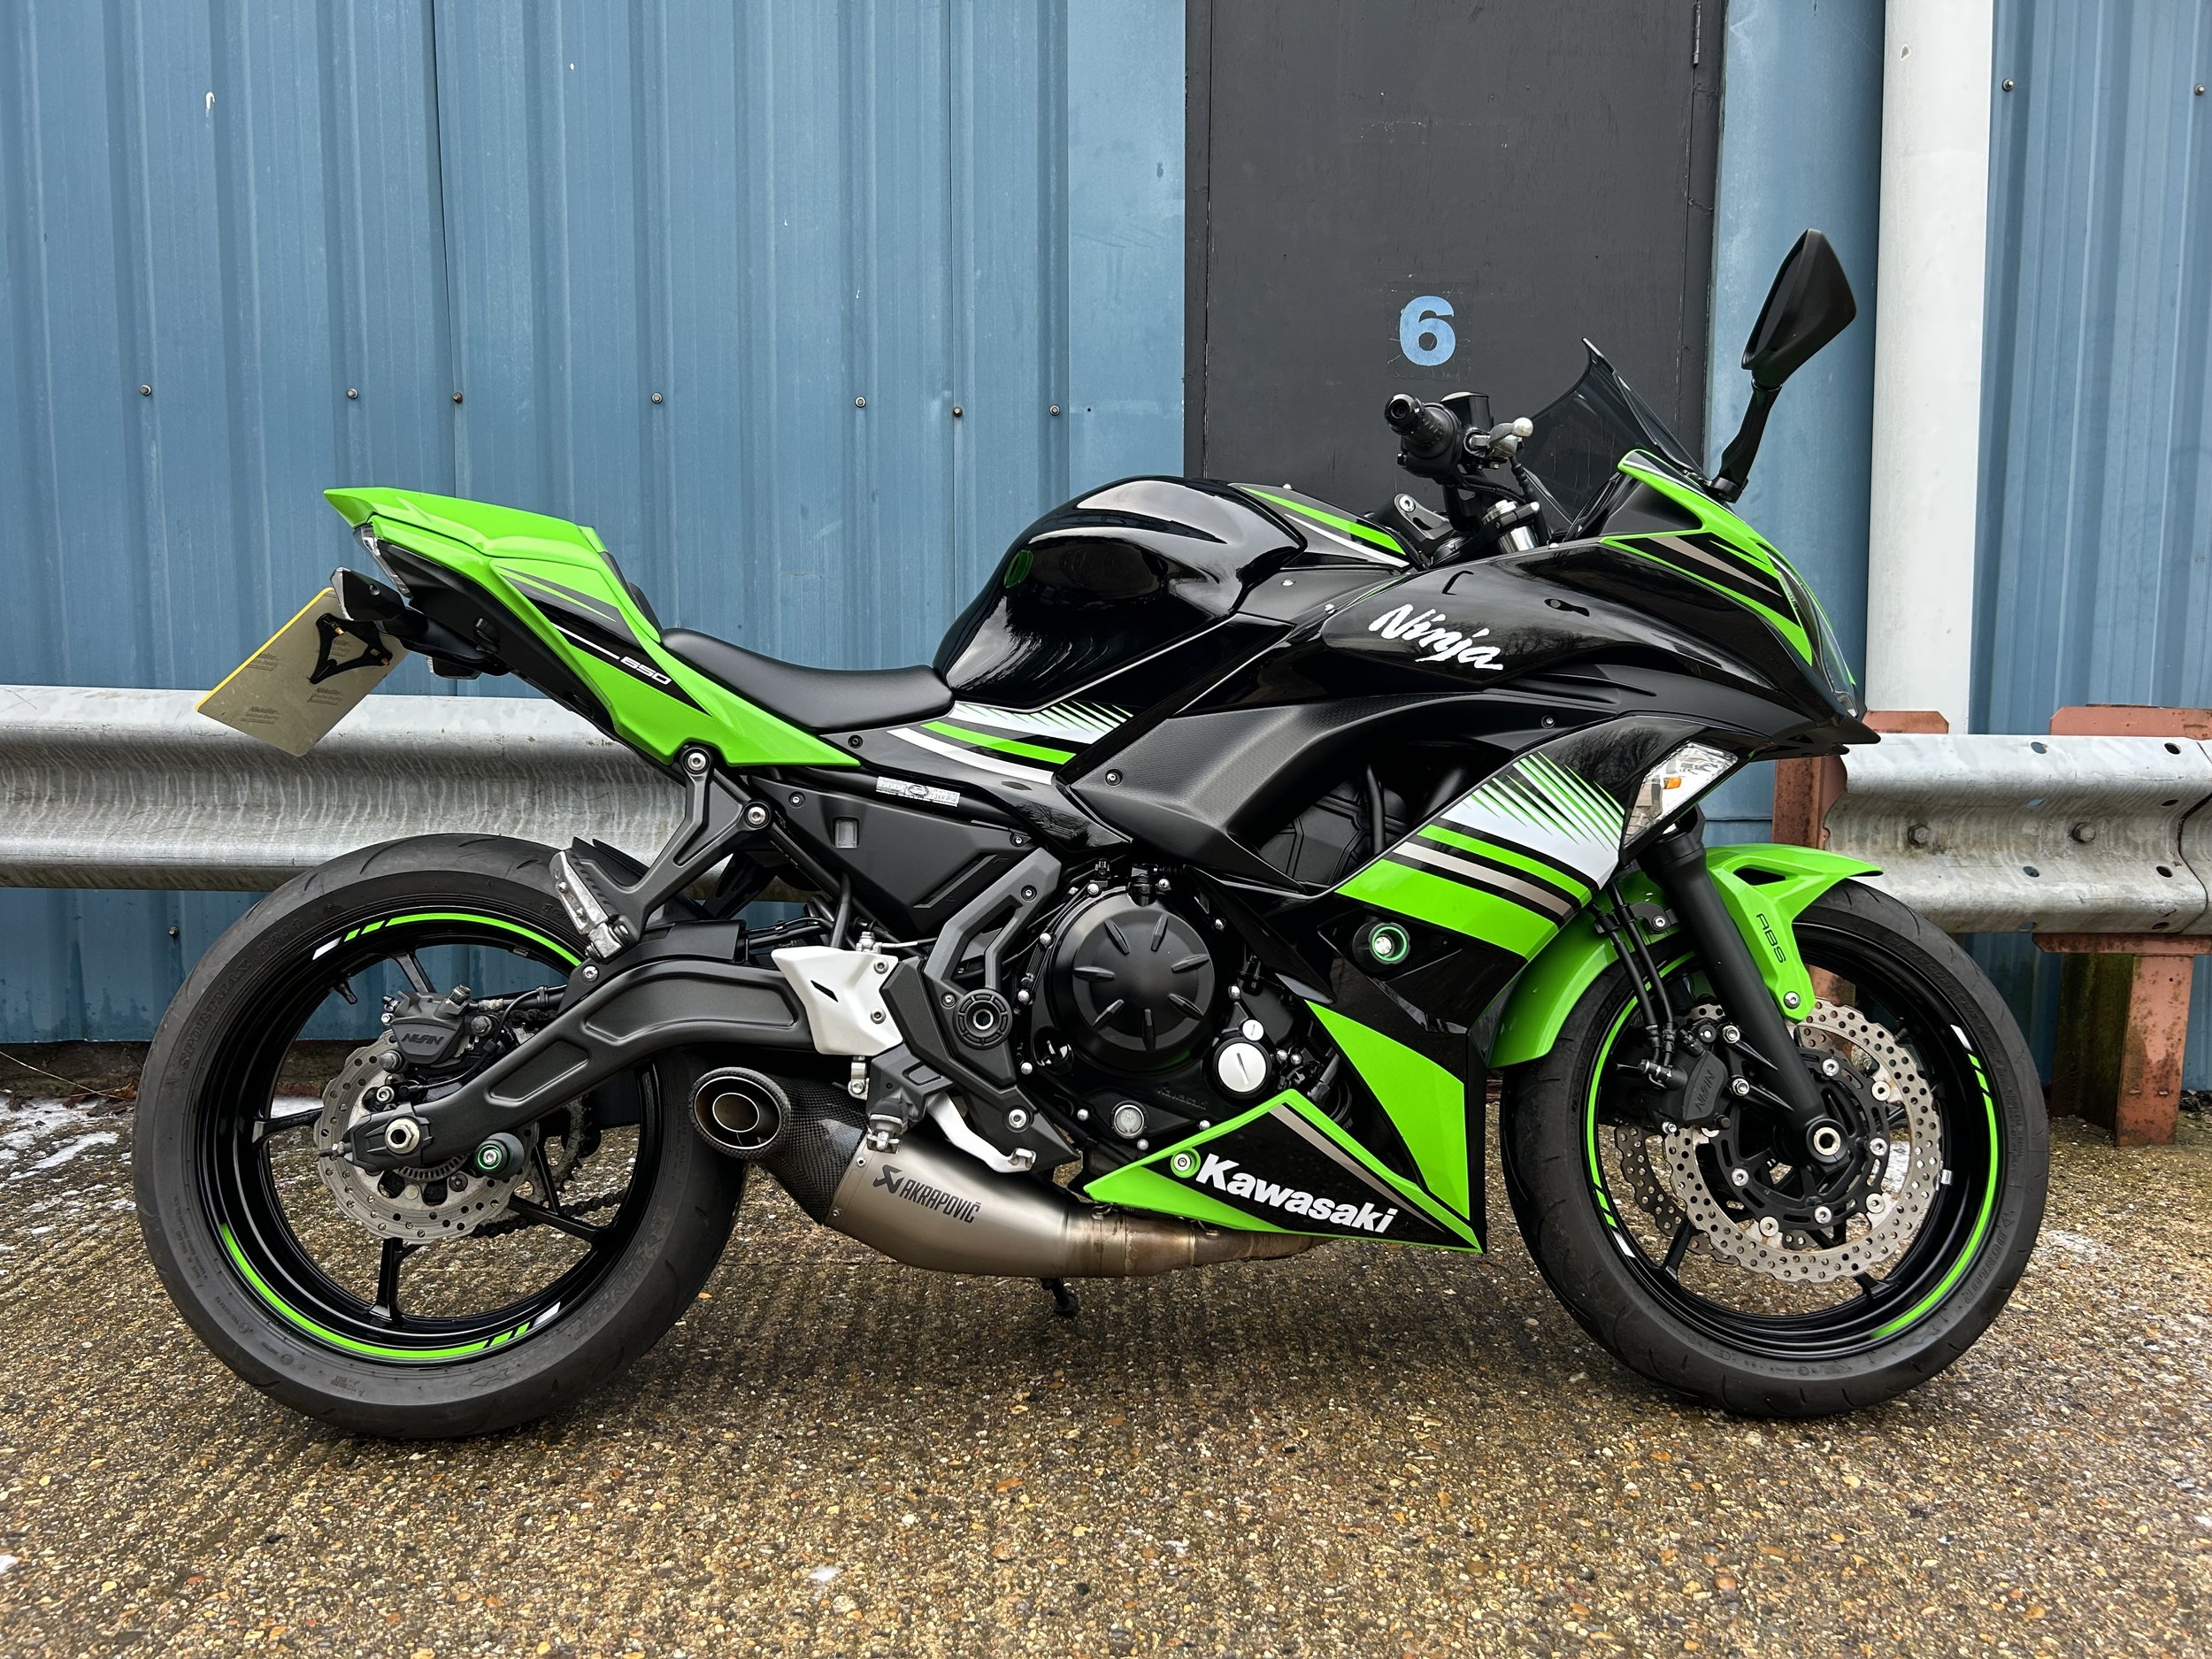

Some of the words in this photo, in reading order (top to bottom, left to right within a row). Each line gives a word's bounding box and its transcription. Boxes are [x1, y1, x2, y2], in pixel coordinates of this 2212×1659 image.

[1400, 296, 1456, 366] 6
[620, 656, 672, 686] 650
[1368, 603, 1504, 671] Ninja
[1755, 912, 1786, 964] ABS
[179, 958, 252, 1069] SPORTMAX
[1195, 1153, 1399, 1233] Kawasaki
